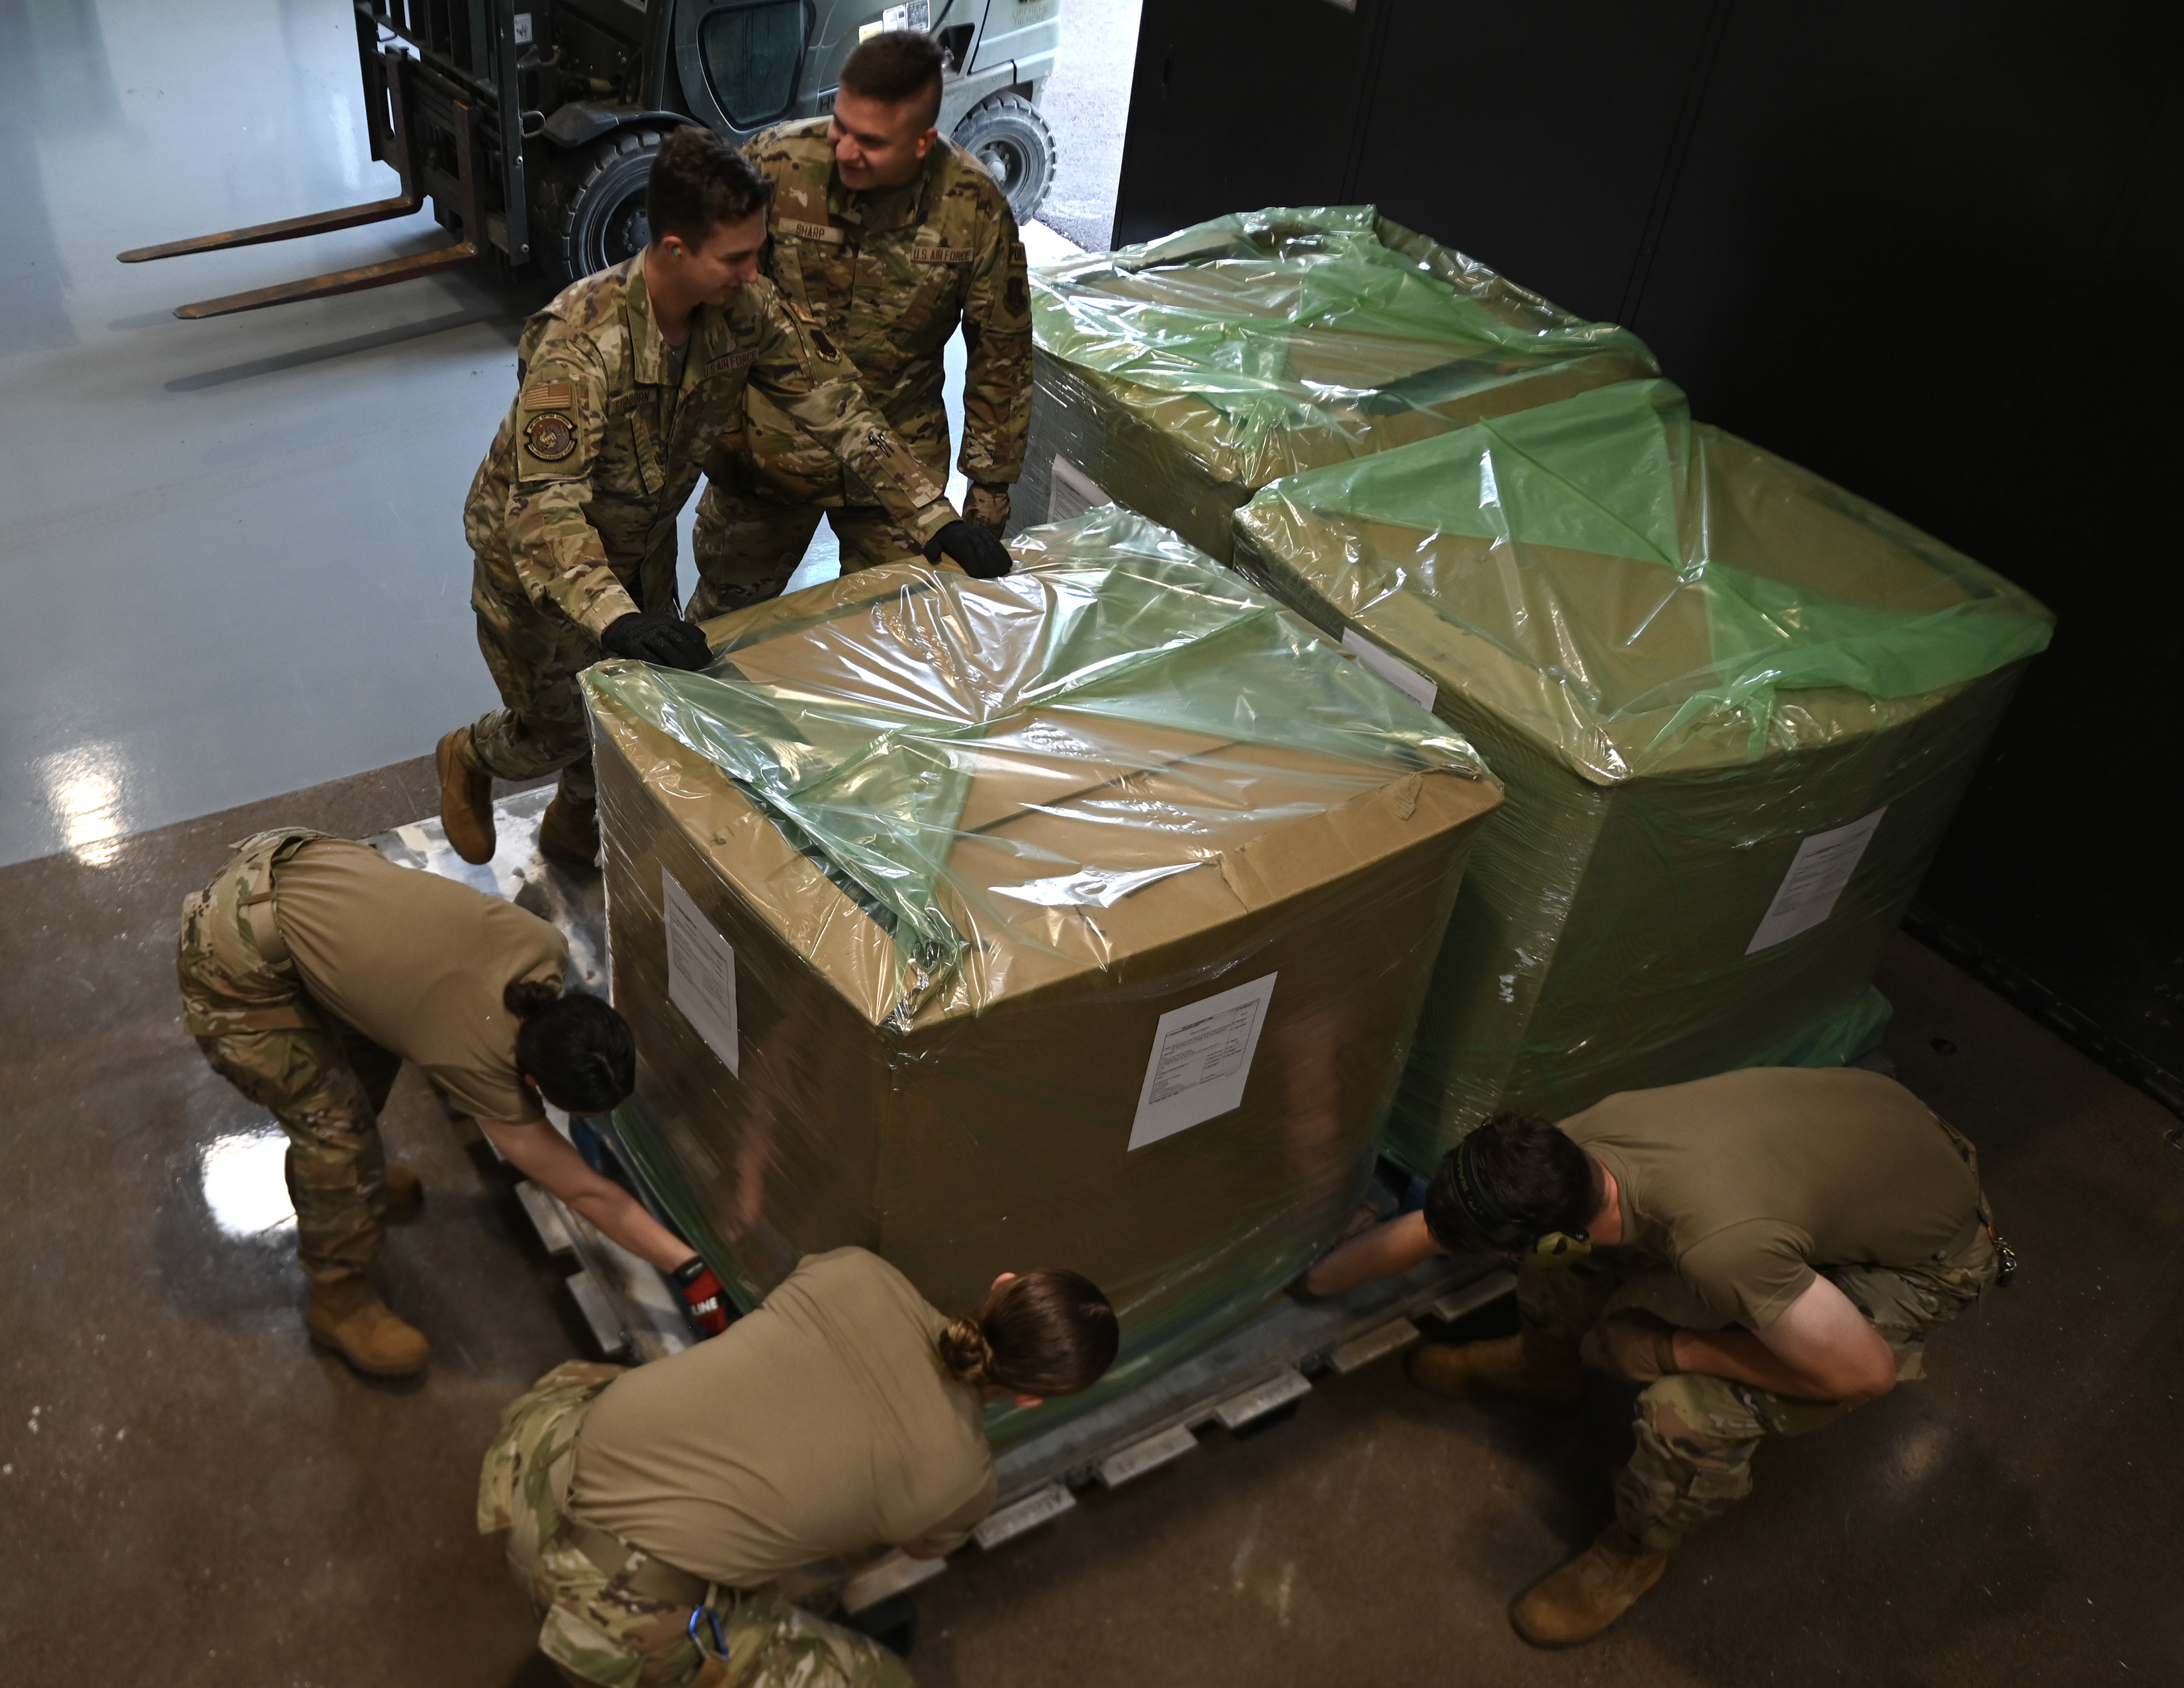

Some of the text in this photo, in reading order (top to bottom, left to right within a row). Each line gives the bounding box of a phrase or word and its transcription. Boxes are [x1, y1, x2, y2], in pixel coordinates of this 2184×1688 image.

[796, 224, 825, 240] SHARP
[913, 248, 969, 261] U.S. AIR FORCE
[717, 358, 729, 371] AIR
[730, 350, 757, 368] FORCE
